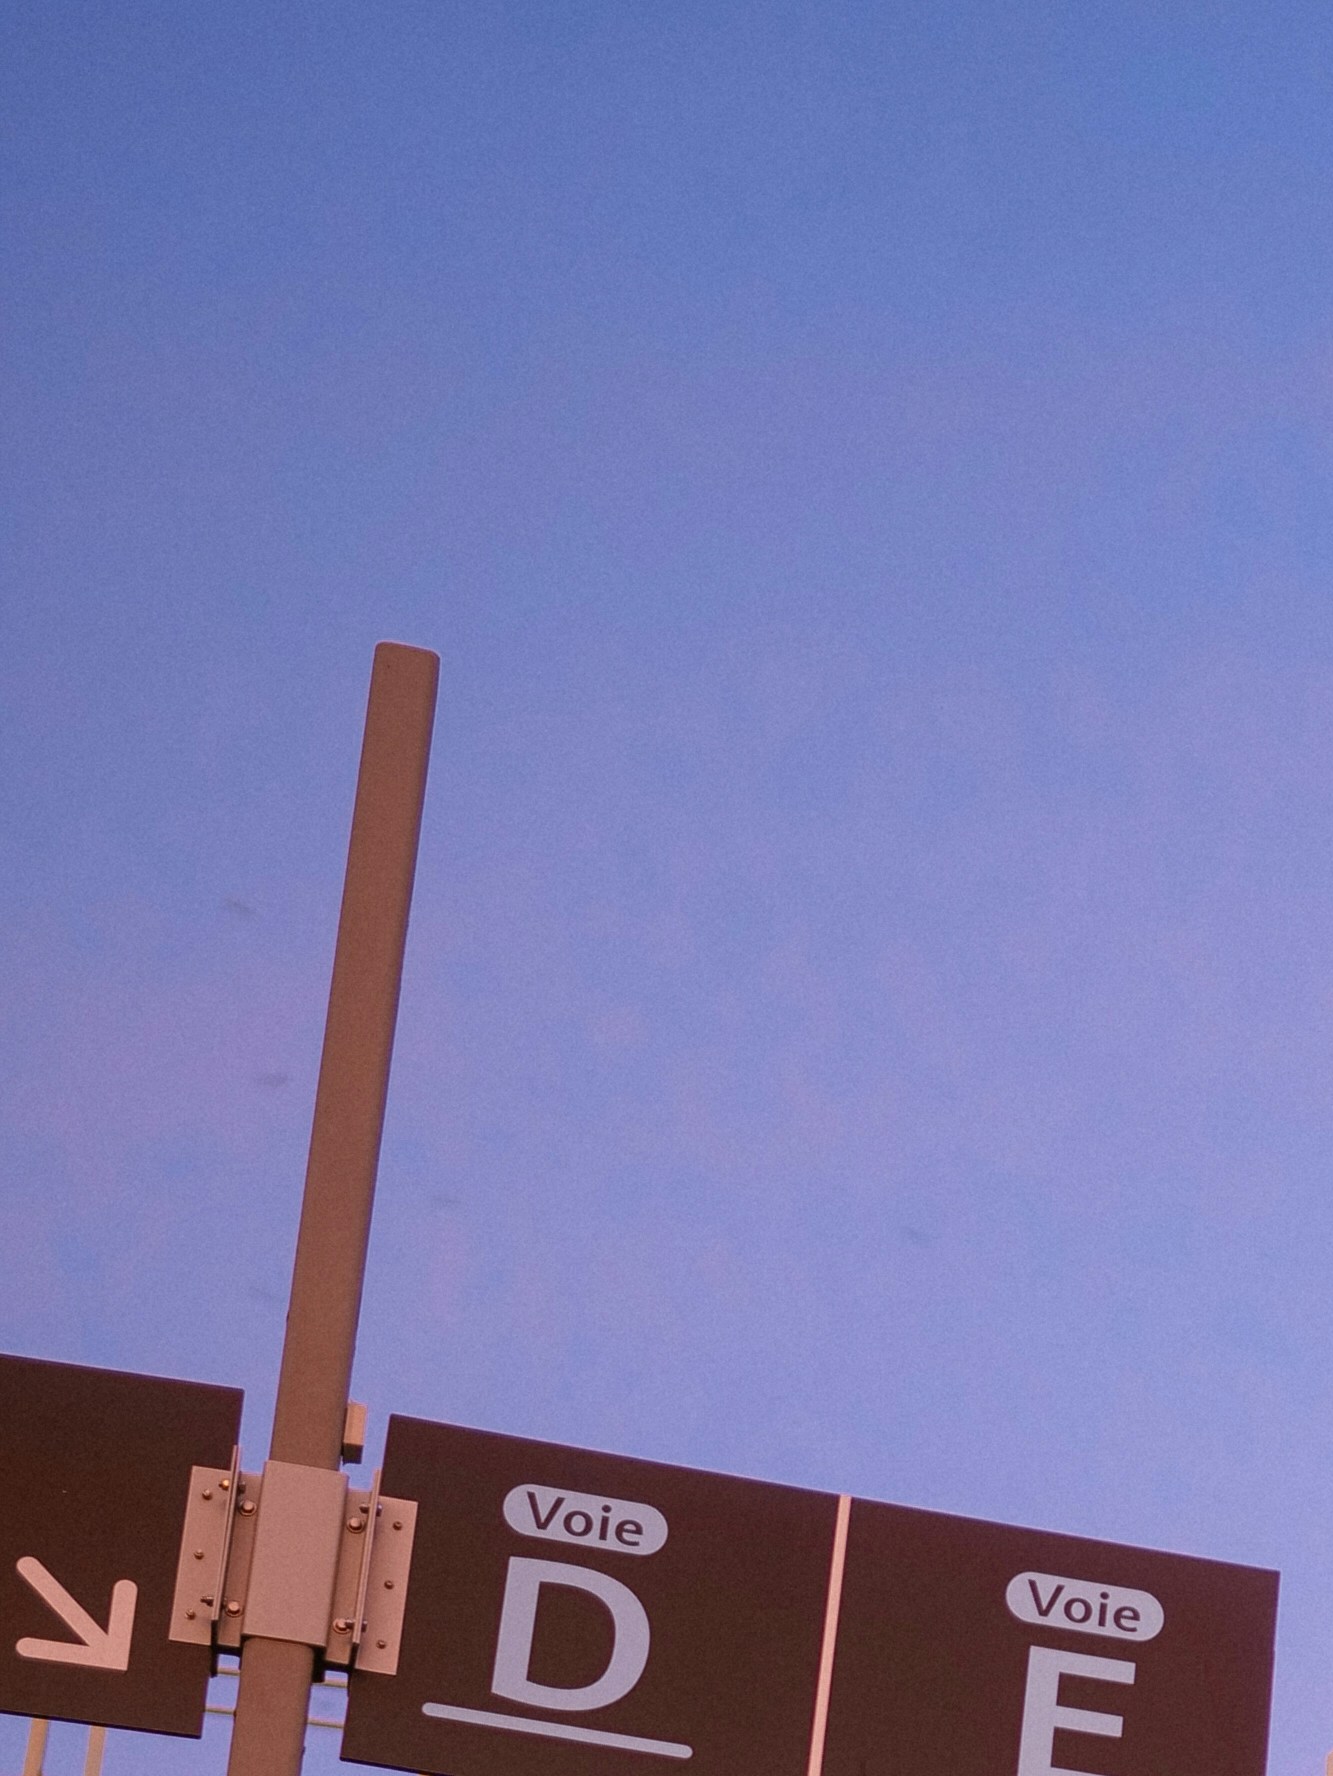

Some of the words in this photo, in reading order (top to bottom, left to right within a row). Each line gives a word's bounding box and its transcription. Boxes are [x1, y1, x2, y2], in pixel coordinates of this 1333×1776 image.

[526, 1491, 643, 1547] Voie
[1027, 1578, 1141, 1632] Voie
[491, 1556, 650, 1711] D
